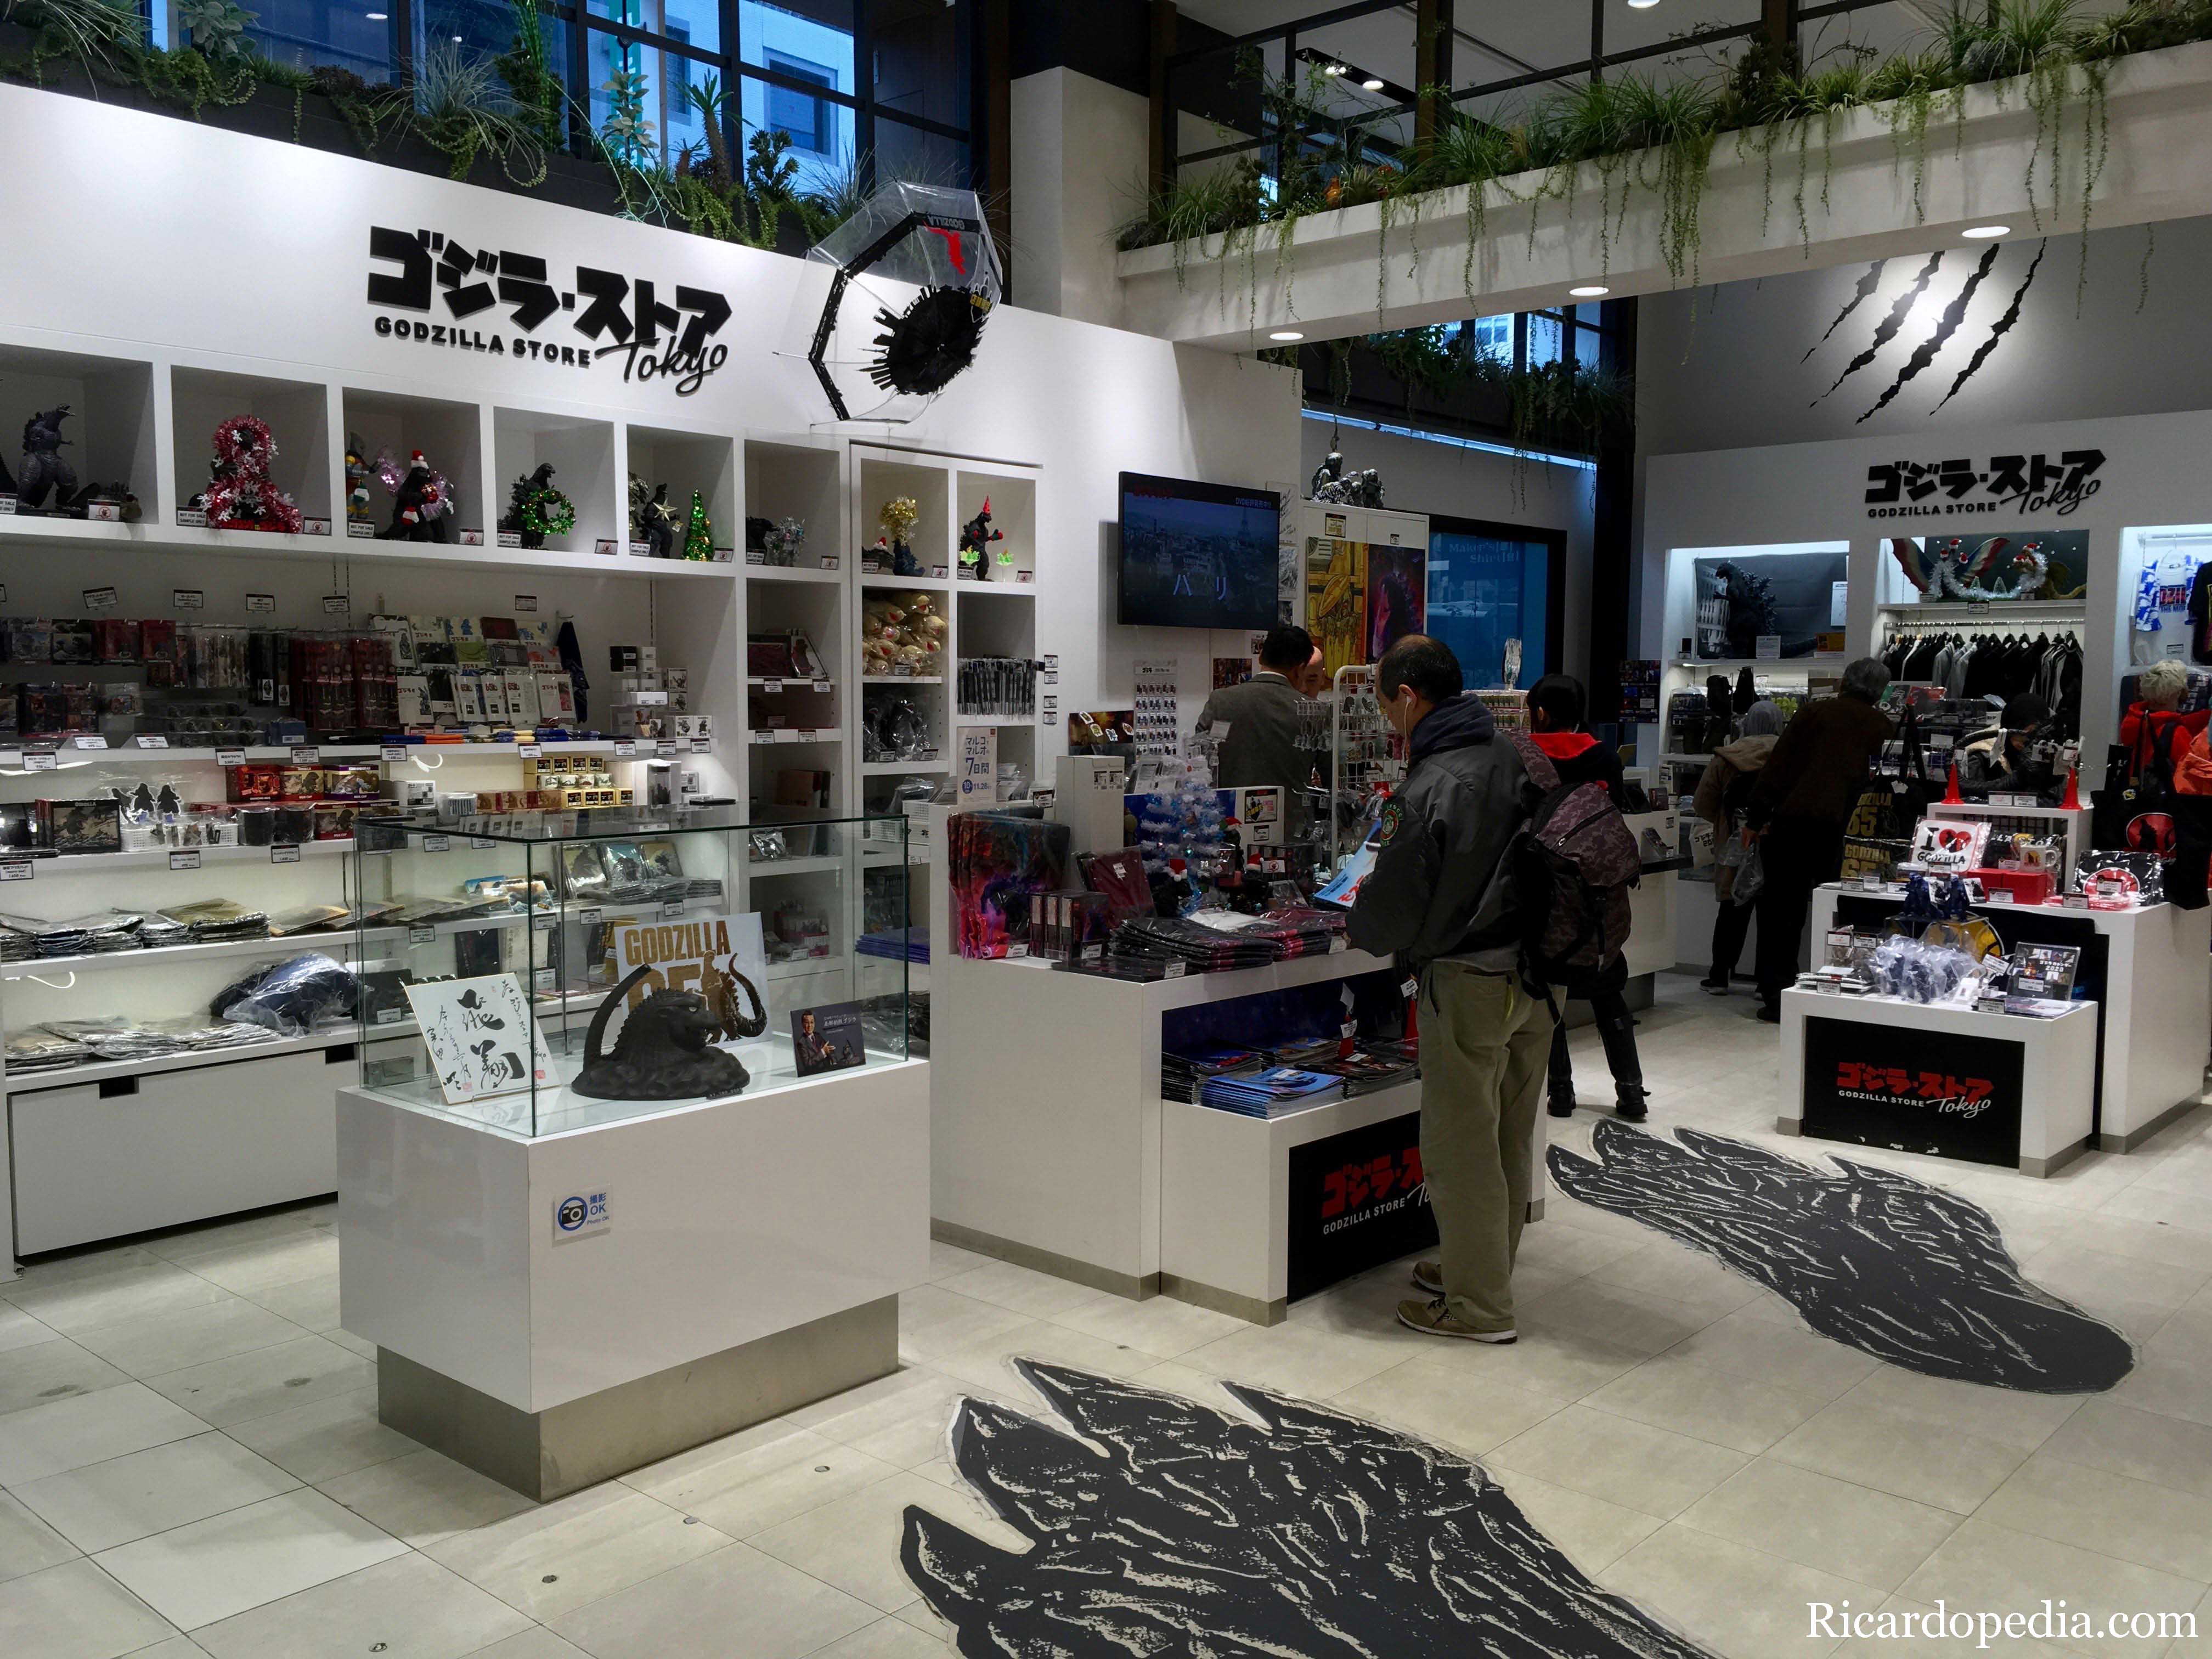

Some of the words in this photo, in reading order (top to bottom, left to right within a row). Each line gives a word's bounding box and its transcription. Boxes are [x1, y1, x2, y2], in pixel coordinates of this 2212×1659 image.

[368, 225, 732, 354] ゴジラ・ストア
[375, 316, 505, 352] GODZILLA
[512, 338, 591, 366] STORE
[594, 335, 729, 397] Tokyo
[1865, 449, 2107, 503] ゴジラ・ストア
[1868, 506, 1940, 518] GODZILLA
[1945, 502, 1996, 514] STORE
[2000, 479, 2101, 516] Tokyo
[966, 757, 989, 776] 7日間
[624, 921, 731, 966] GODZILLA
[1837, 1062, 1994, 1103] ゴジラ・ストア
[1838, 1090, 1887, 1103] GODZILLA
[1891, 1096, 1925, 1107] STORE
[1926, 1096, 1991, 1119] Tokyo
[590, 1203, 606, 1215] OK
[1323, 1209, 1370, 1234] GODZILLA
[1374, 1197, 1406, 1217] STORE
